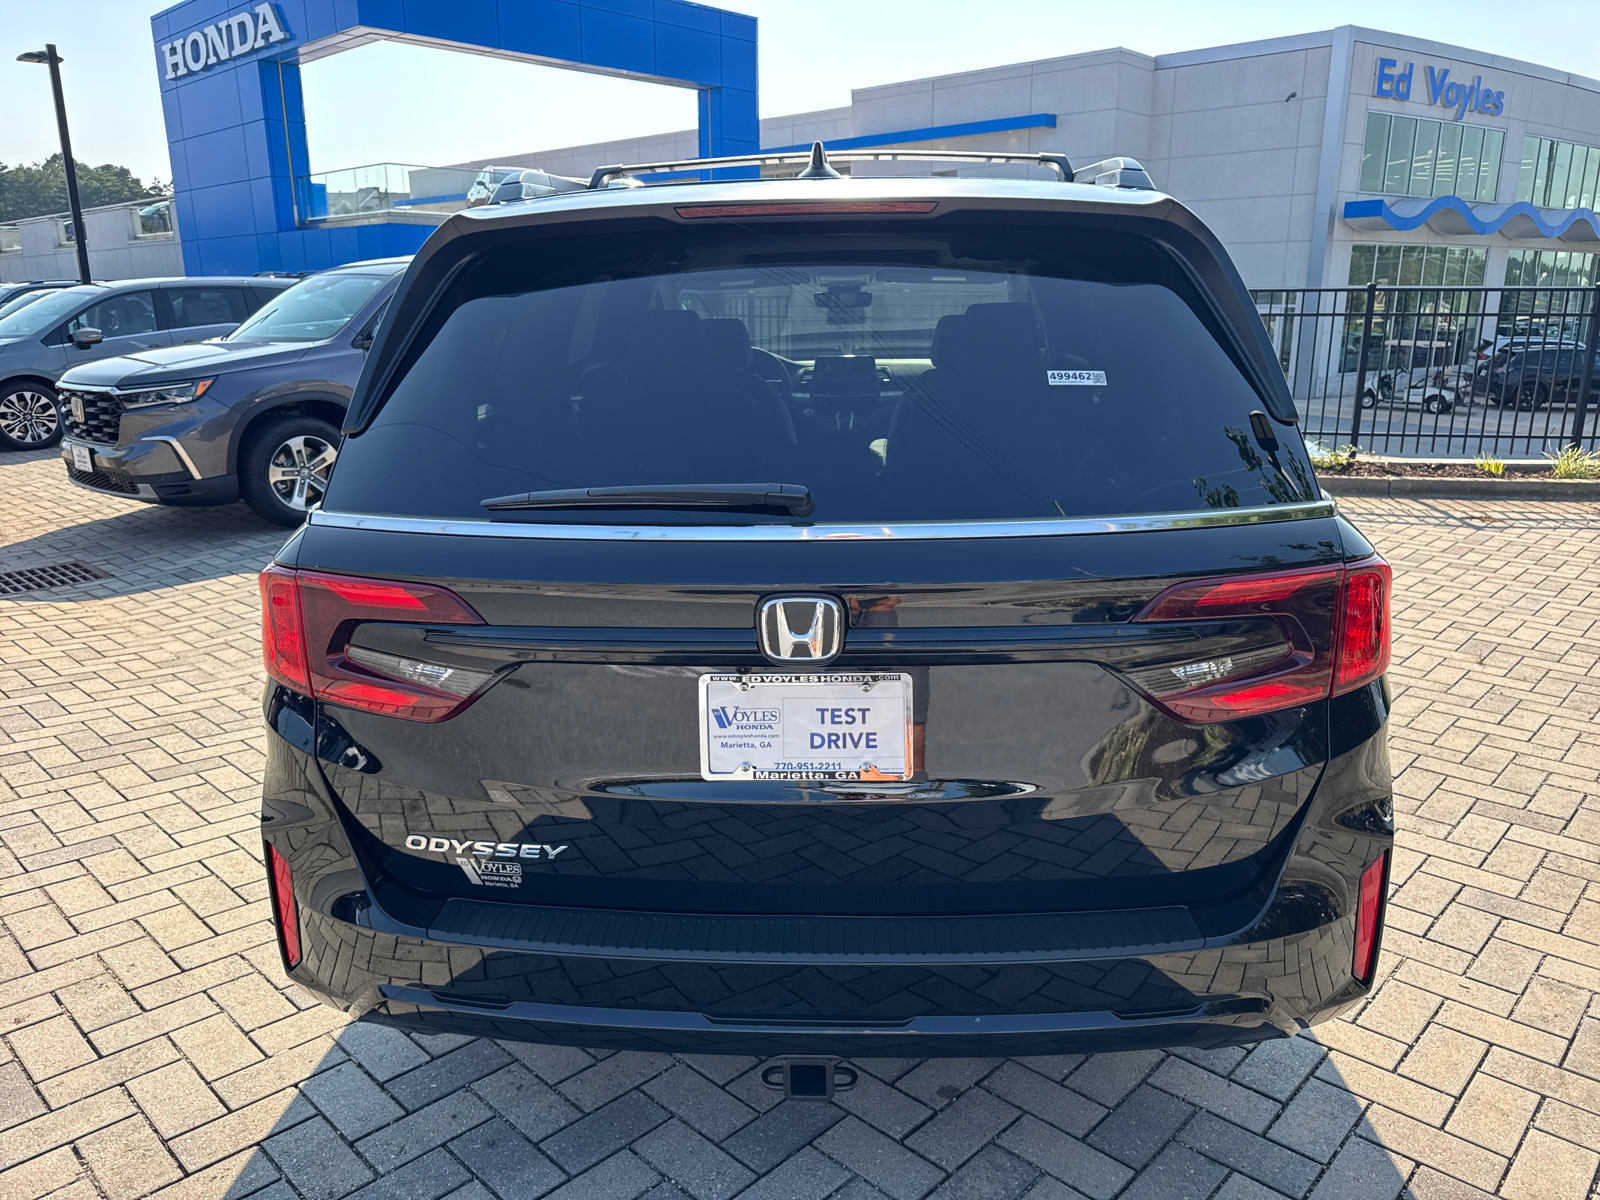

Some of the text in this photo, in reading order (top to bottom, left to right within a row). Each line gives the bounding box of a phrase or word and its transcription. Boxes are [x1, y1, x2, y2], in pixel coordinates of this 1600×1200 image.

[161, 2, 287, 80] HONDA
[1373, 57, 1505, 121] Ed Voyles
[1050, 372, 1092, 380] 499462
[720, 706, 778, 727] VOYLES
[816, 707, 870, 725] TEST
[720, 741, 757, 749] Marietta,
[810, 732, 877, 749] DRIVE
[774, 762, 841, 770] 770-951-2211
[755, 771, 858, 780] Marietta, GA
[405, 835, 568, 860] ODYSSEY
[469, 858, 520, 875] VOYLES
